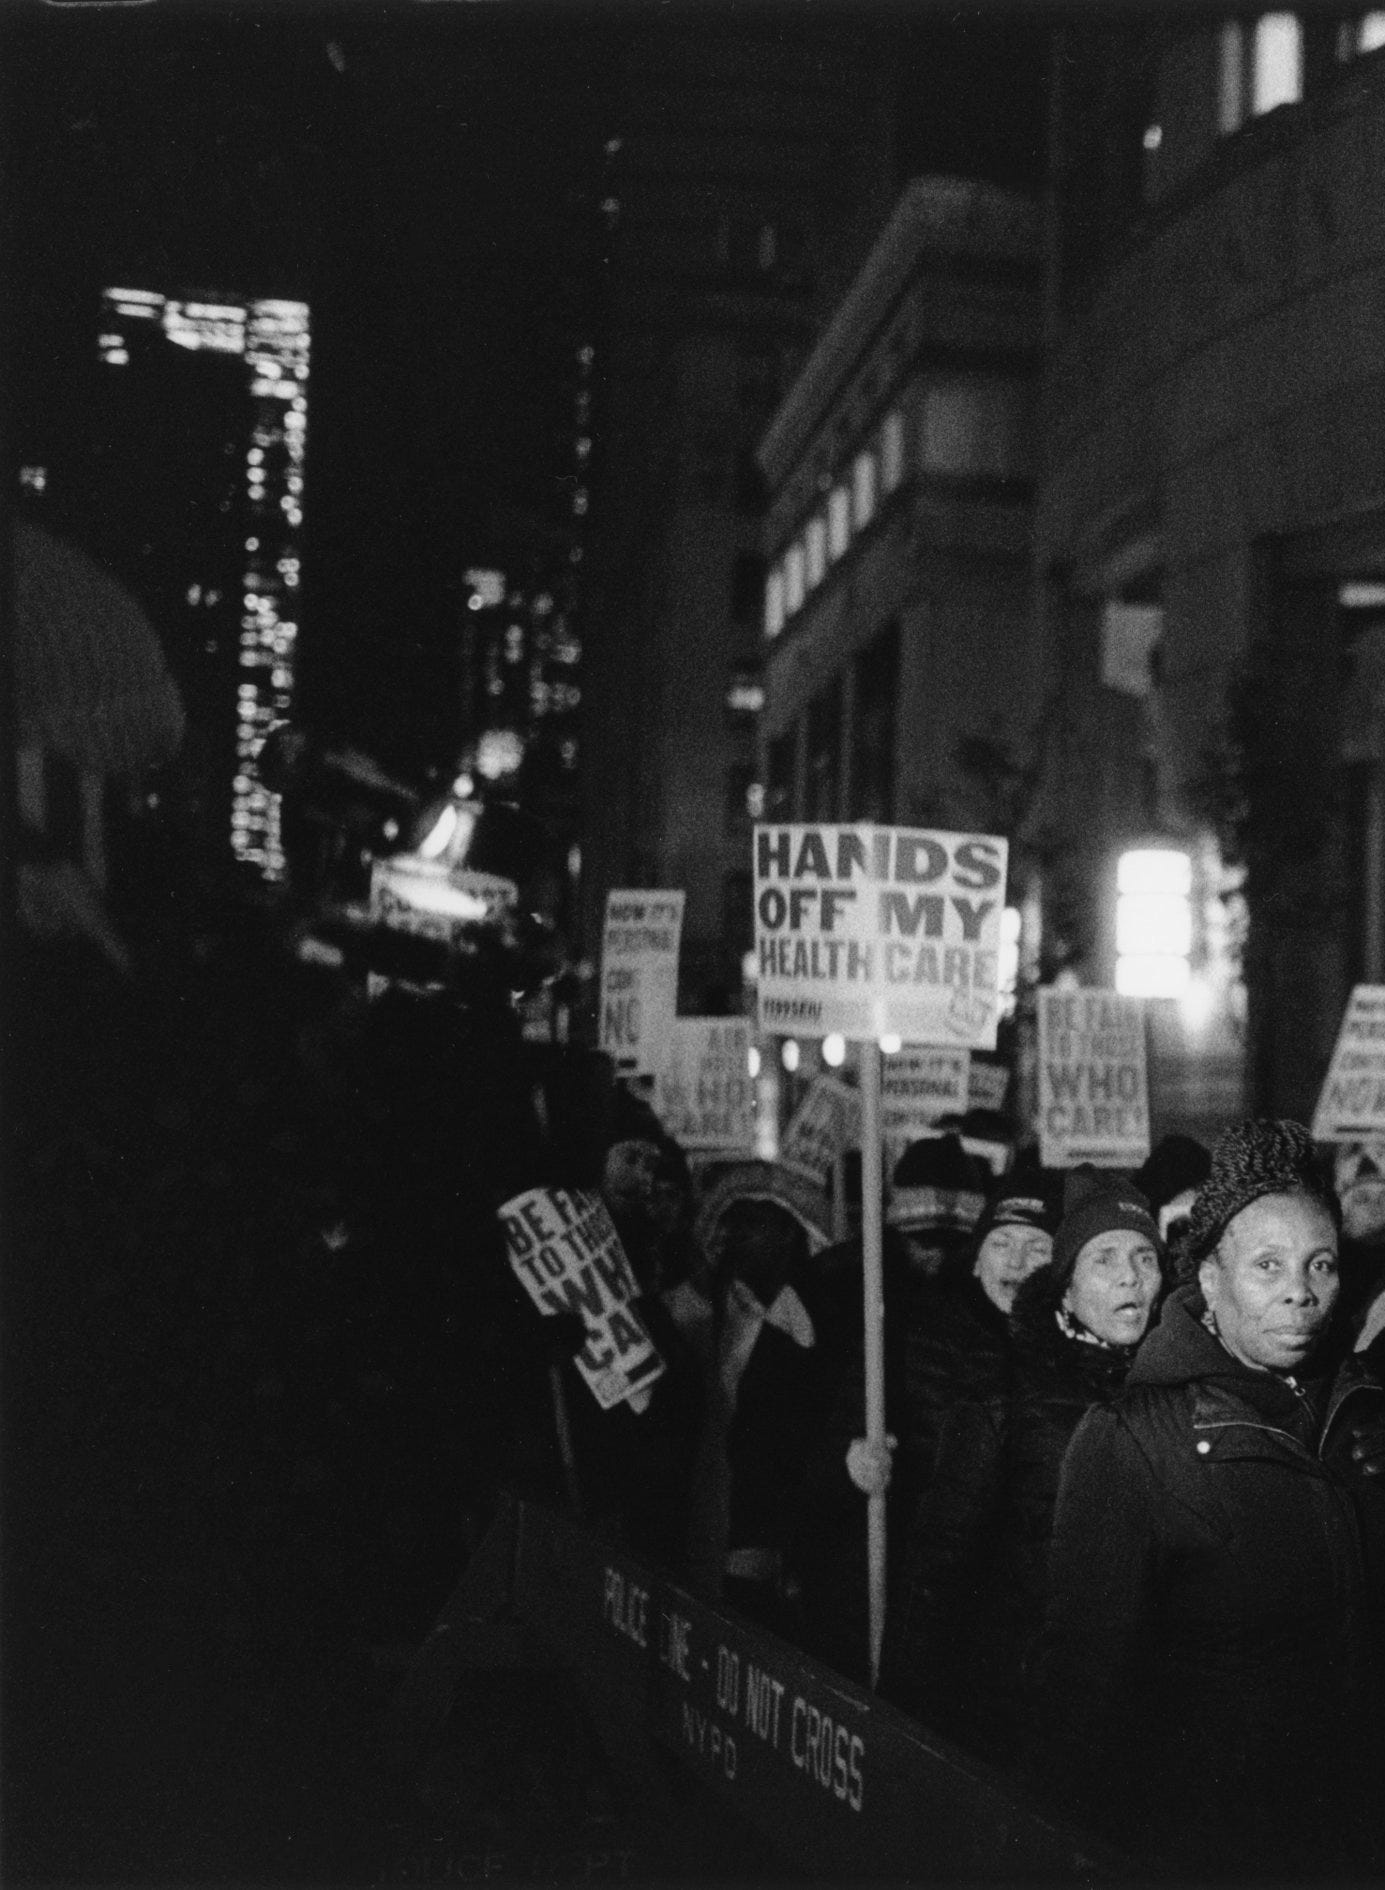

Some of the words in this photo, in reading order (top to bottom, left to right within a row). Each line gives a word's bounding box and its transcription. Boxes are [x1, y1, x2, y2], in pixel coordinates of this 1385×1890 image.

[757, 832, 1001, 890] HANDS
[758, 888, 857, 932] OFF
[877, 891, 998, 942] MY
[759, 938, 873, 982] HEALTH
[884, 942, 997, 990] CARE
[1046, 1062, 1139, 1102] WHO
[506, 1201, 556, 1257] BE
[519, 1246, 567, 1288] TO
[681, 1700, 738, 1781] NYPD
[716, 1643, 740, 1717] DO
[744, 1663, 786, 1750] NOT
[790, 1695, 865, 1813] CROSS
